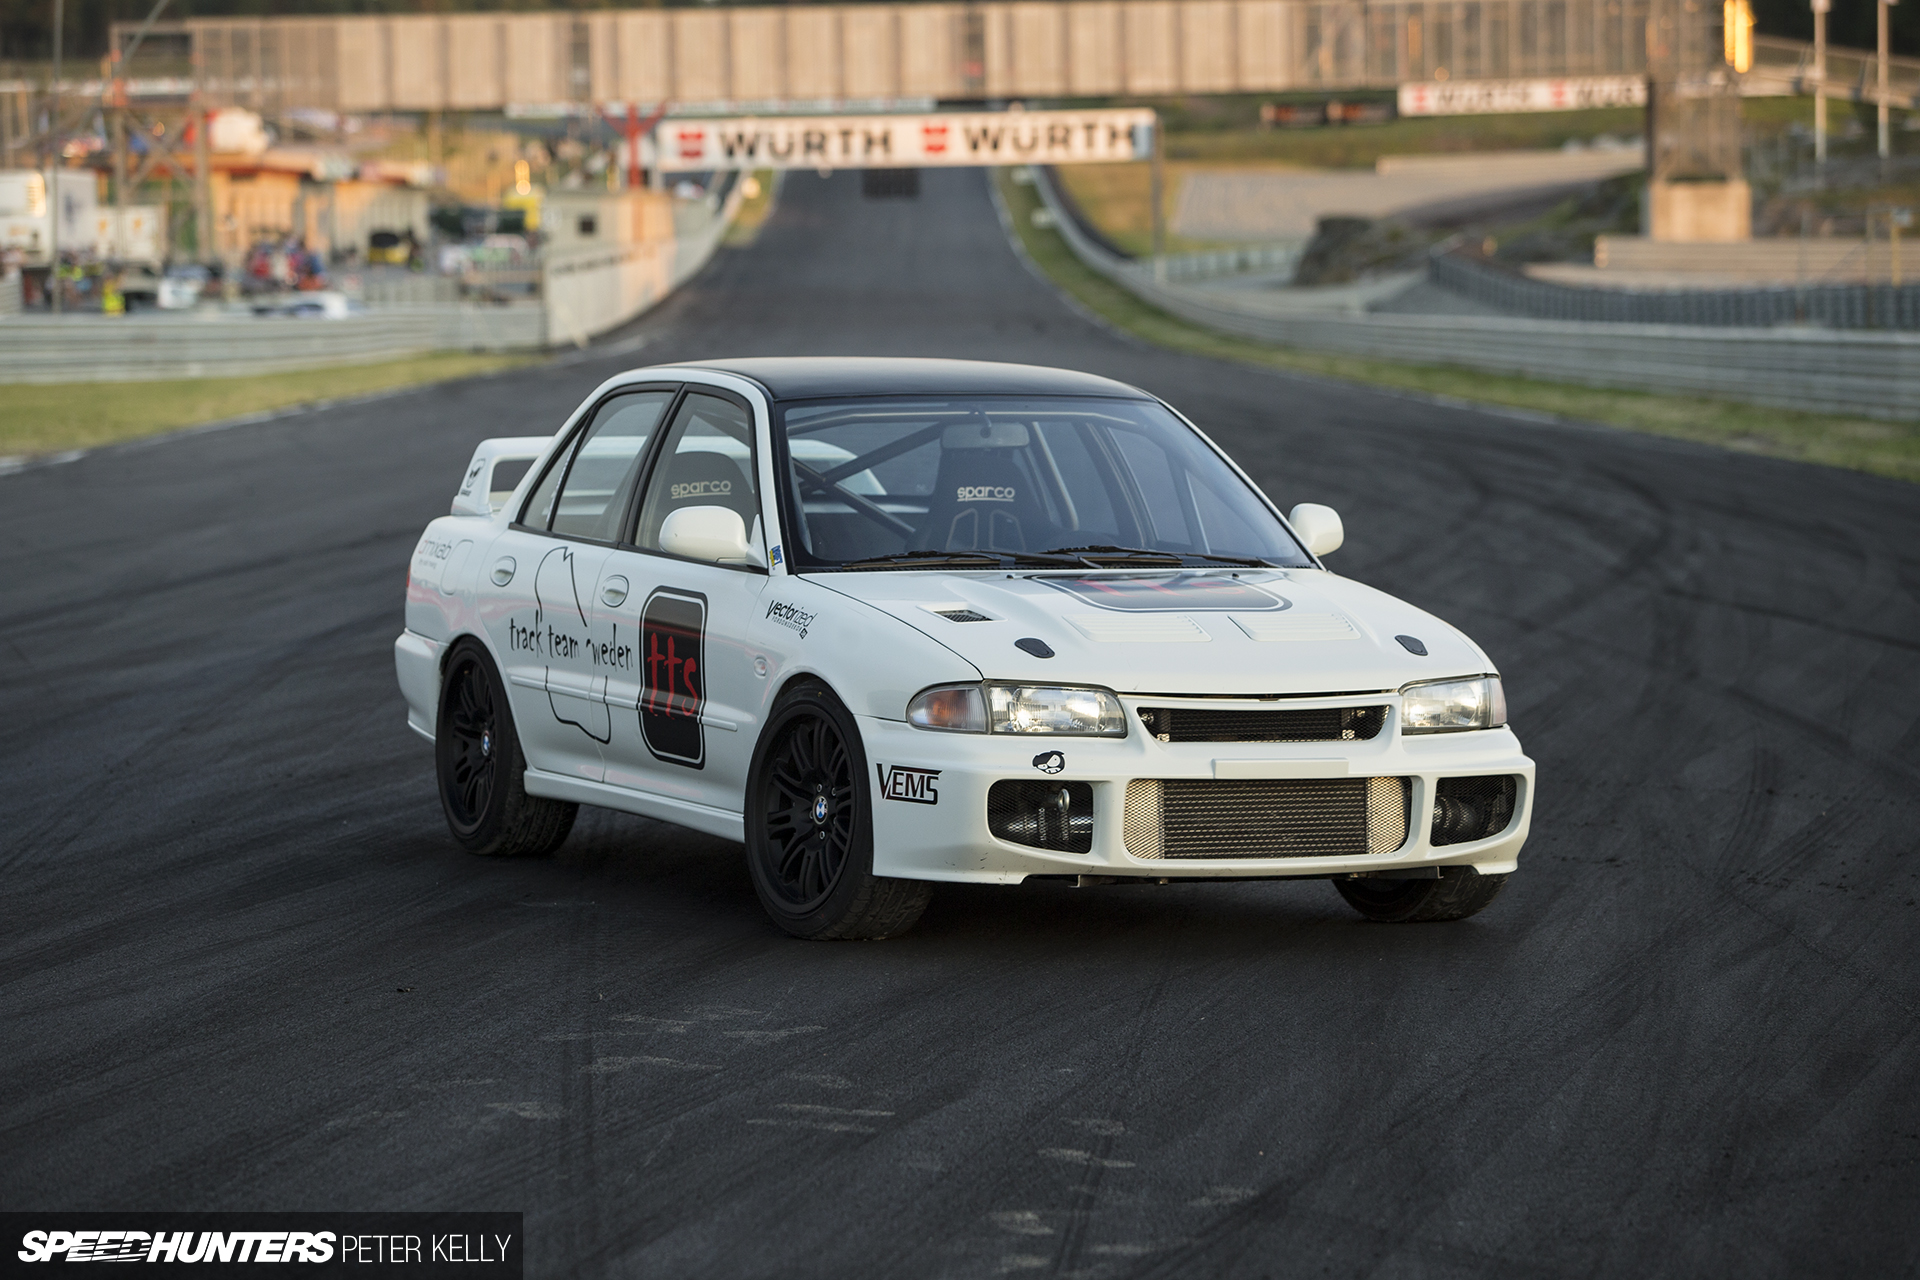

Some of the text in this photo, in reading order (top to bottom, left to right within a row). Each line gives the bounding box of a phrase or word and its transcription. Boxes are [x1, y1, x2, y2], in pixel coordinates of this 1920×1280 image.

[671, 480, 732, 499] sparco
[957, 486, 1015, 502] sparco
[509, 609, 543, 658] track
[548, 624, 579, 659] team
[647, 632, 697, 720] tts
[876, 762, 943, 805] VEMS
